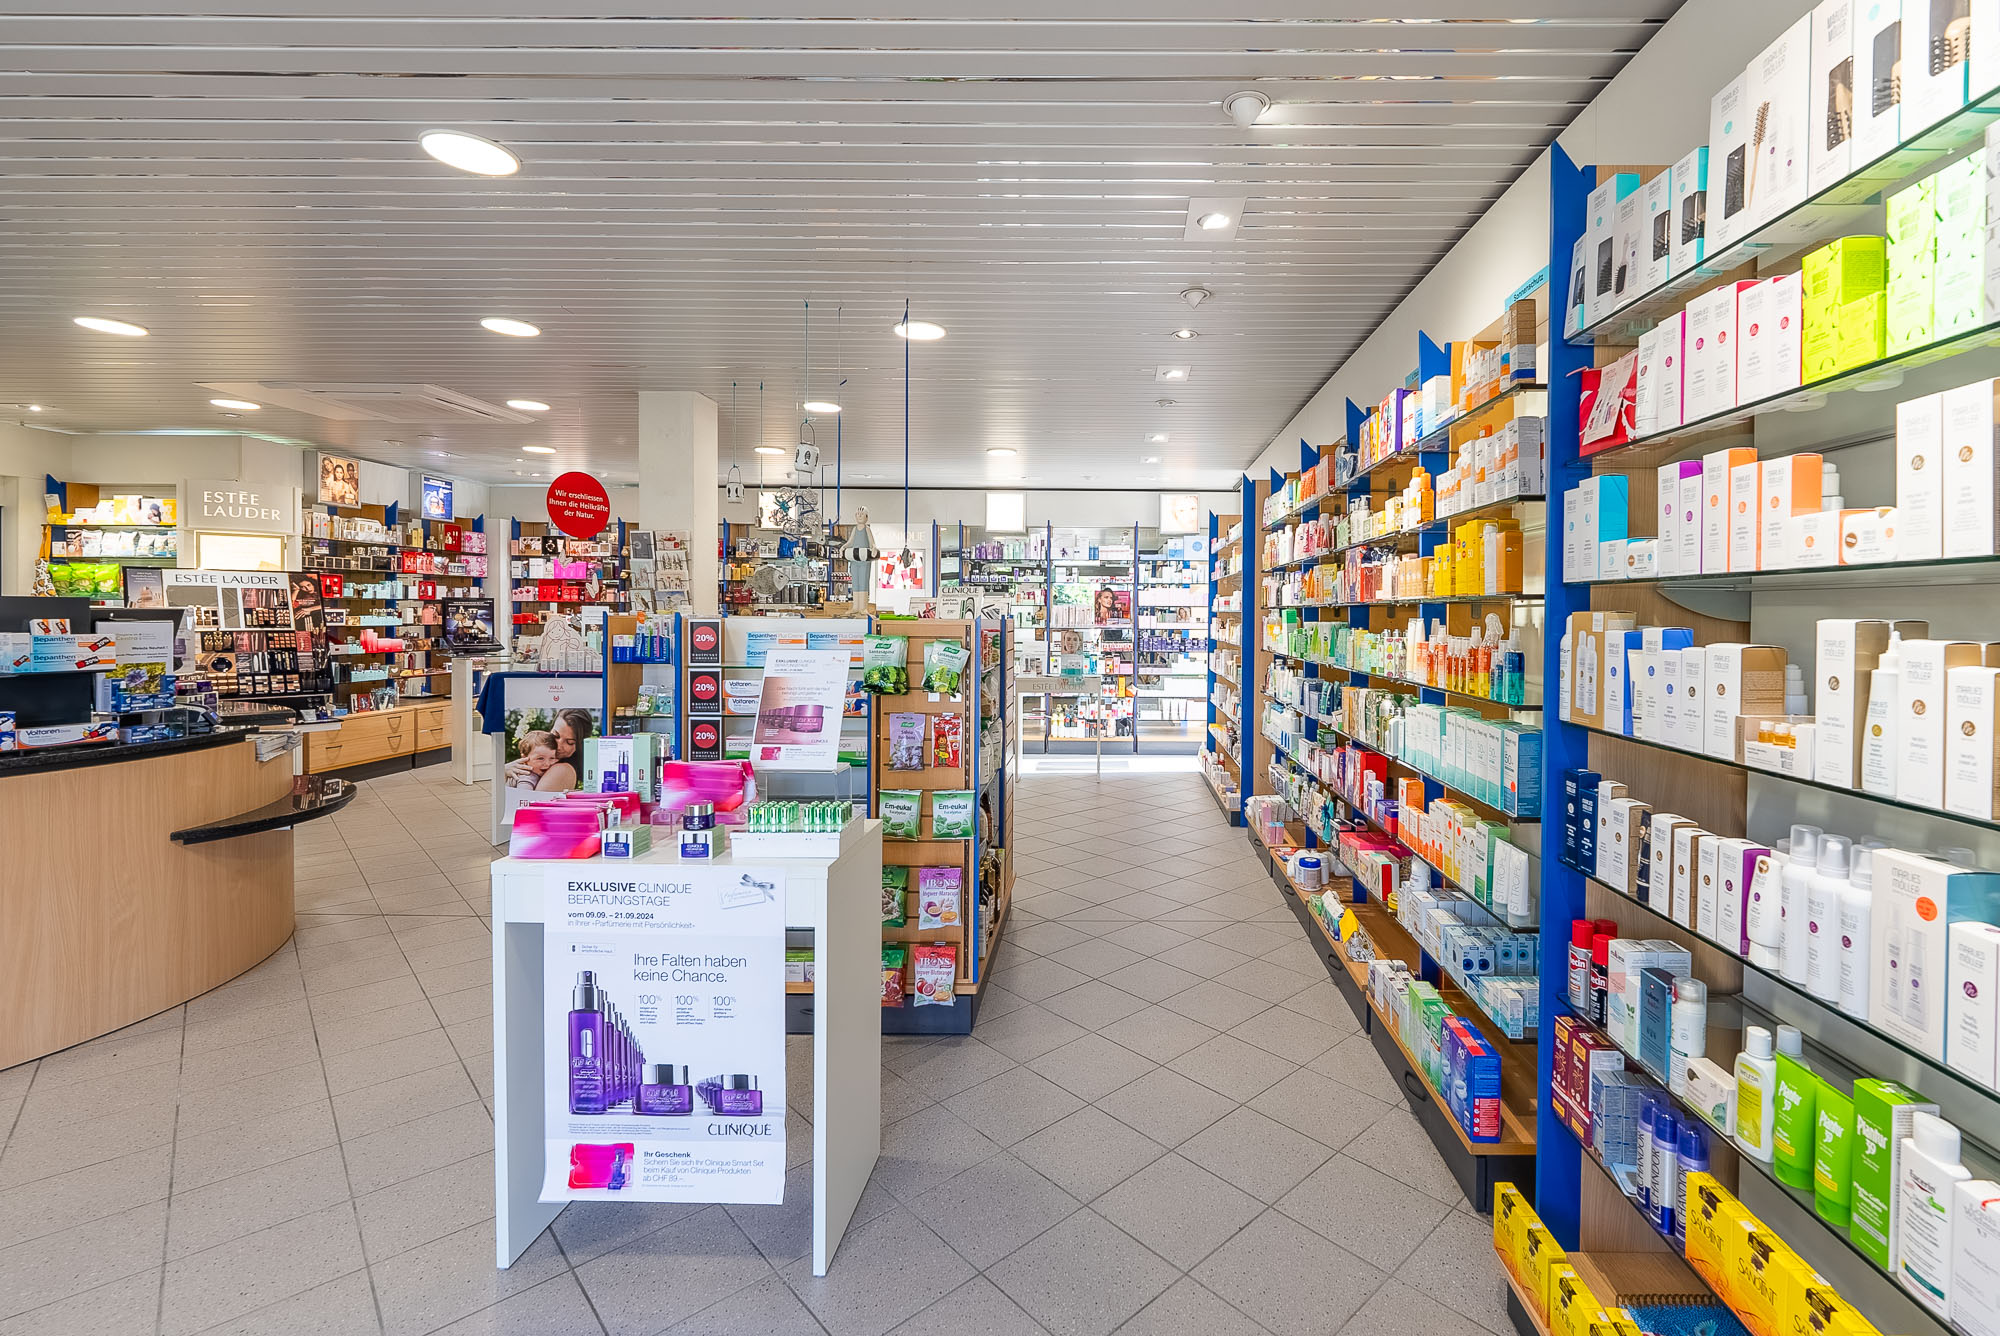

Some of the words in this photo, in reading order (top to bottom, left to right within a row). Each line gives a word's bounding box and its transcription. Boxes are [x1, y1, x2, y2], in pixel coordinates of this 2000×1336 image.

[1514, 274, 1544, 302] Sonnenschutz
[204, 491, 260, 506] ESTÉE
[568, 492, 604, 502] erschliessen
[204, 504, 280, 520] LAUDER
[549, 498, 567, 506] Ihnen
[580, 502, 608, 512] Heilkräfte
[576, 511, 595, 519] Natur.
[222, 575, 278, 584] LAUDER
[97, 638, 110, 647] 20%
[885, 803, 912, 811] Em-eukal
[1892, 867, 1921, 884] MARLIES
[568, 882, 636, 892] EXKLUSIVE
[638, 883, 692, 894] CLINIQUE
[1892, 878, 1920, 895] MÖLLER
[568, 894, 671, 906] BERATUNGSTAGE
[634, 953, 658, 966] Ihre
[662, 954, 701, 967] Falten
[704, 955, 747, 968] haben
[634, 968, 668, 981] keine
[672, 969, 727, 983] Chance.
[638, 994, 662, 1005] 100%
[675, 995, 699, 1005] 100%
[712, 996, 736, 1006] 100%
[1778, 1080, 1802, 1106] Plantur
[1782, 1098, 1792, 1111] 39
[708, 1122, 772, 1137] CLINIQUE
[1819, 1110, 1844, 1138] Plantur
[1824, 1130, 1834, 1143] 39
[1857, 1114, 1888, 1150] Plantur
[1866, 1140, 1877, 1155] 39
[1651, 1148, 1660, 1206] CHANDOR
[1909, 1169, 1936, 1194] Eucerin
[1677, 1165, 1688, 1226] CHANDOR
[1691, 1209, 1724, 1252] SANOTINT
[1738, 1258, 1777, 1306] SANOTINT
